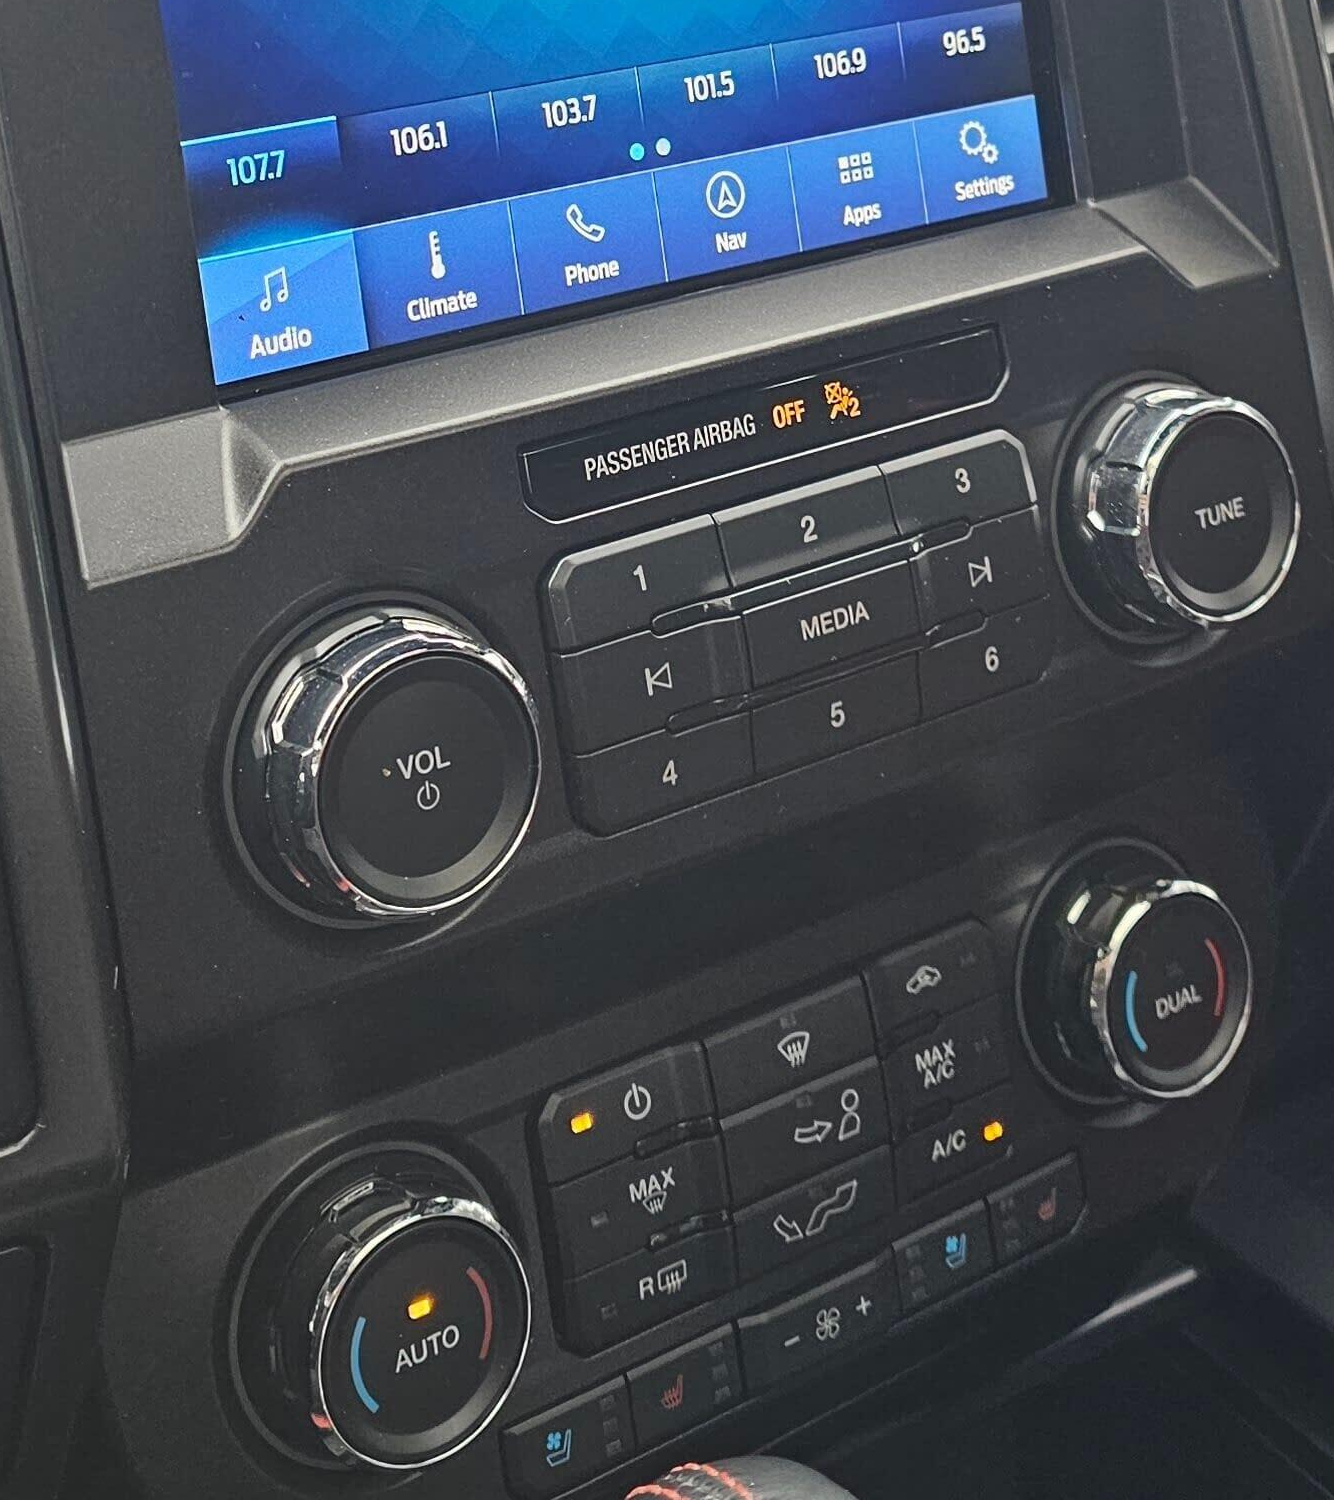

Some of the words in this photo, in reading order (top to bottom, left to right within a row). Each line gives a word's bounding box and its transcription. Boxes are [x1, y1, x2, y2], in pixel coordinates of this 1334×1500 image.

[942, 25, 987, 58] 96.5
[813, 47, 867, 80] 106.9
[683, 69, 735, 103] 101.5
[541, 94, 598, 129] 103.7
[390, 120, 449, 157] 106.1
[226, 150, 286, 186] 107.7
[954, 171, 1015, 202] Settings
[842, 202, 881, 228] Apps
[715, 230, 747, 254] Nav
[564, 259, 620, 287] Phone
[406, 289, 478, 322] Climate
[249, 326, 312, 360] Audio
[583, 431, 691, 481] PASSENGER
[693, 414, 756, 451] AIRBAG
[772, 399, 806, 429] OFF
[954, 467, 971, 493] 3
[800, 515, 818, 542] 2
[1193, 496, 1246, 531] TUNE
[632, 564, 648, 591] 1
[800, 600, 870, 641] MEDIA
[985, 646, 1000, 672] 6
[829, 702, 846, 728] 5
[396, 746, 451, 780] VOL
[661, 759, 678, 786] 4
[1154, 983, 1203, 1020] DUAL
[914, 1038, 956, 1074] MAX
[923, 1059, 955, 1089] A/C
[931, 1128, 966, 1162] A/C
[628, 1165, 675, 1202] MAX
[639, 1275, 655, 1300] R
[395, 1325, 460, 1373] AUTO
